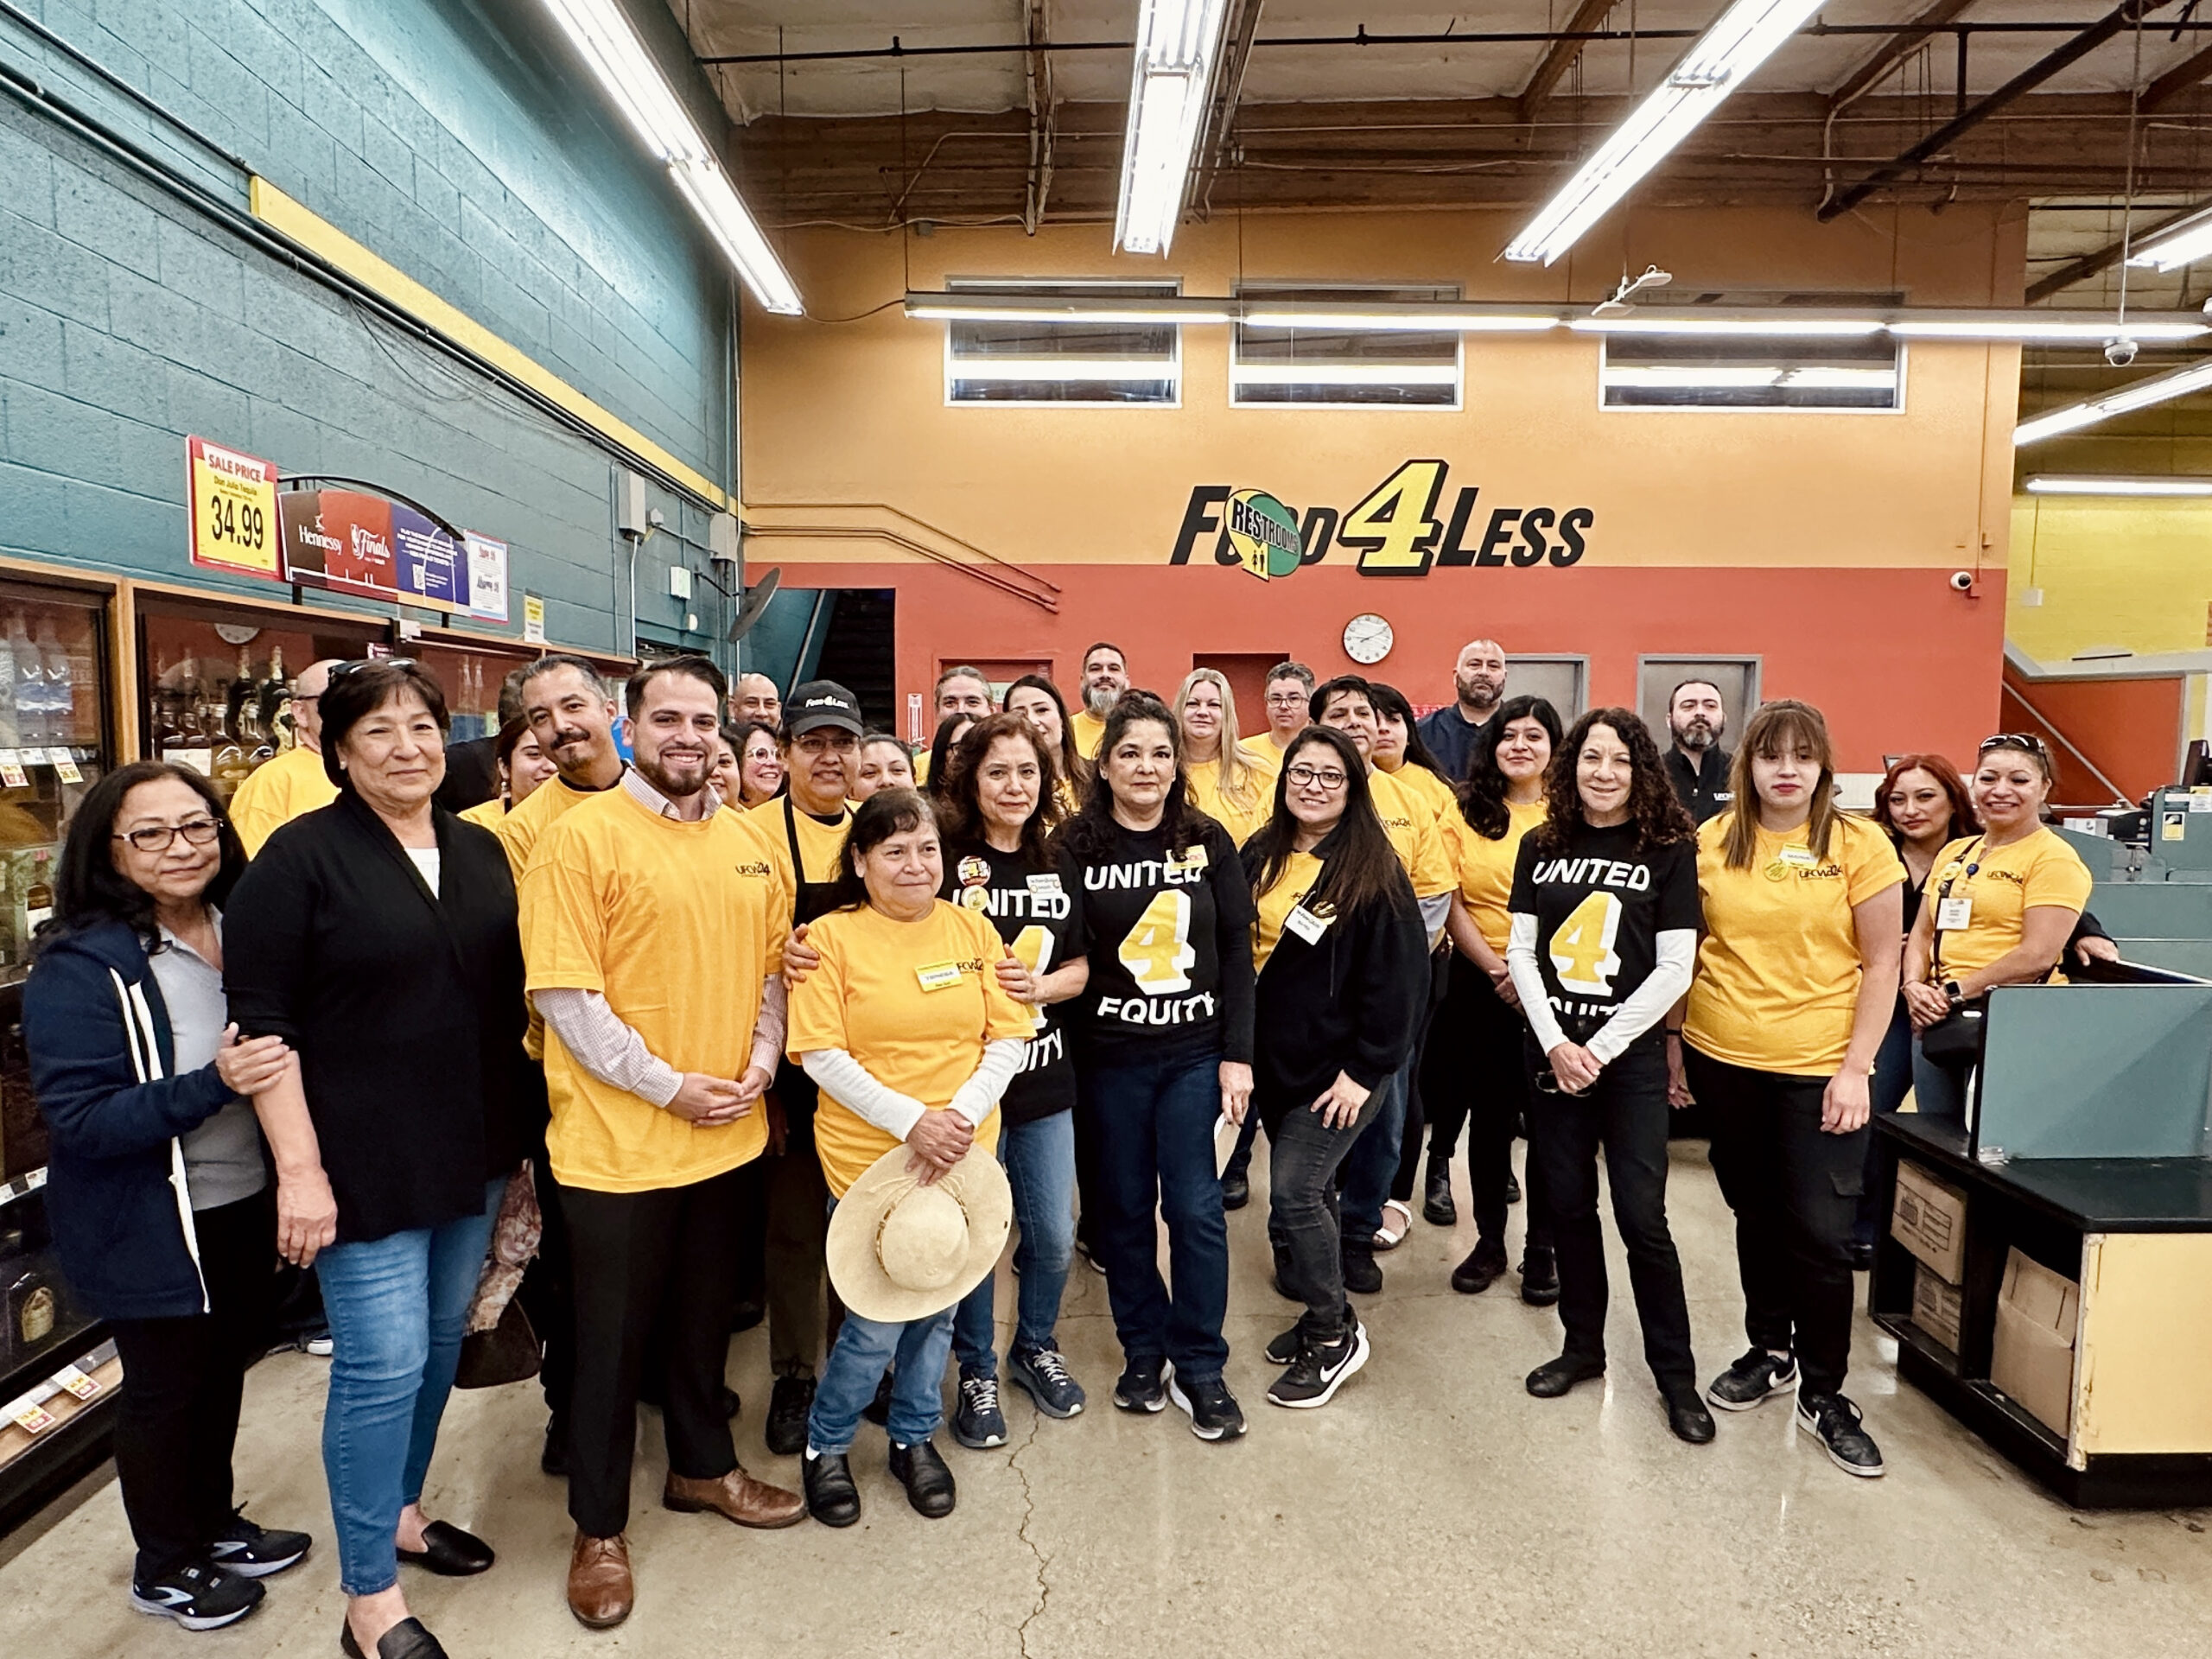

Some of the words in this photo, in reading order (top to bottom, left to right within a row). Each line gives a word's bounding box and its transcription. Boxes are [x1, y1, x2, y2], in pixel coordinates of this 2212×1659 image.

[209, 454, 232, 474] SALE
[234, 463, 261, 483] PRICE
[214, 475, 225, 486] Don
[212, 495, 264, 550] 34.99
[1169, 486, 1338, 566] FD
[1337, 459, 1449, 576] 4
[1435, 487, 1593, 567] LESS
[1231, 498, 1299, 554] RESTROOMS
[299, 524, 343, 556] Hennessy
[356, 529, 391, 561] Finals
[1532, 858, 1650, 892] UNITED
[1118, 888, 1196, 995] 4
[1549, 890, 1623, 996] 4
